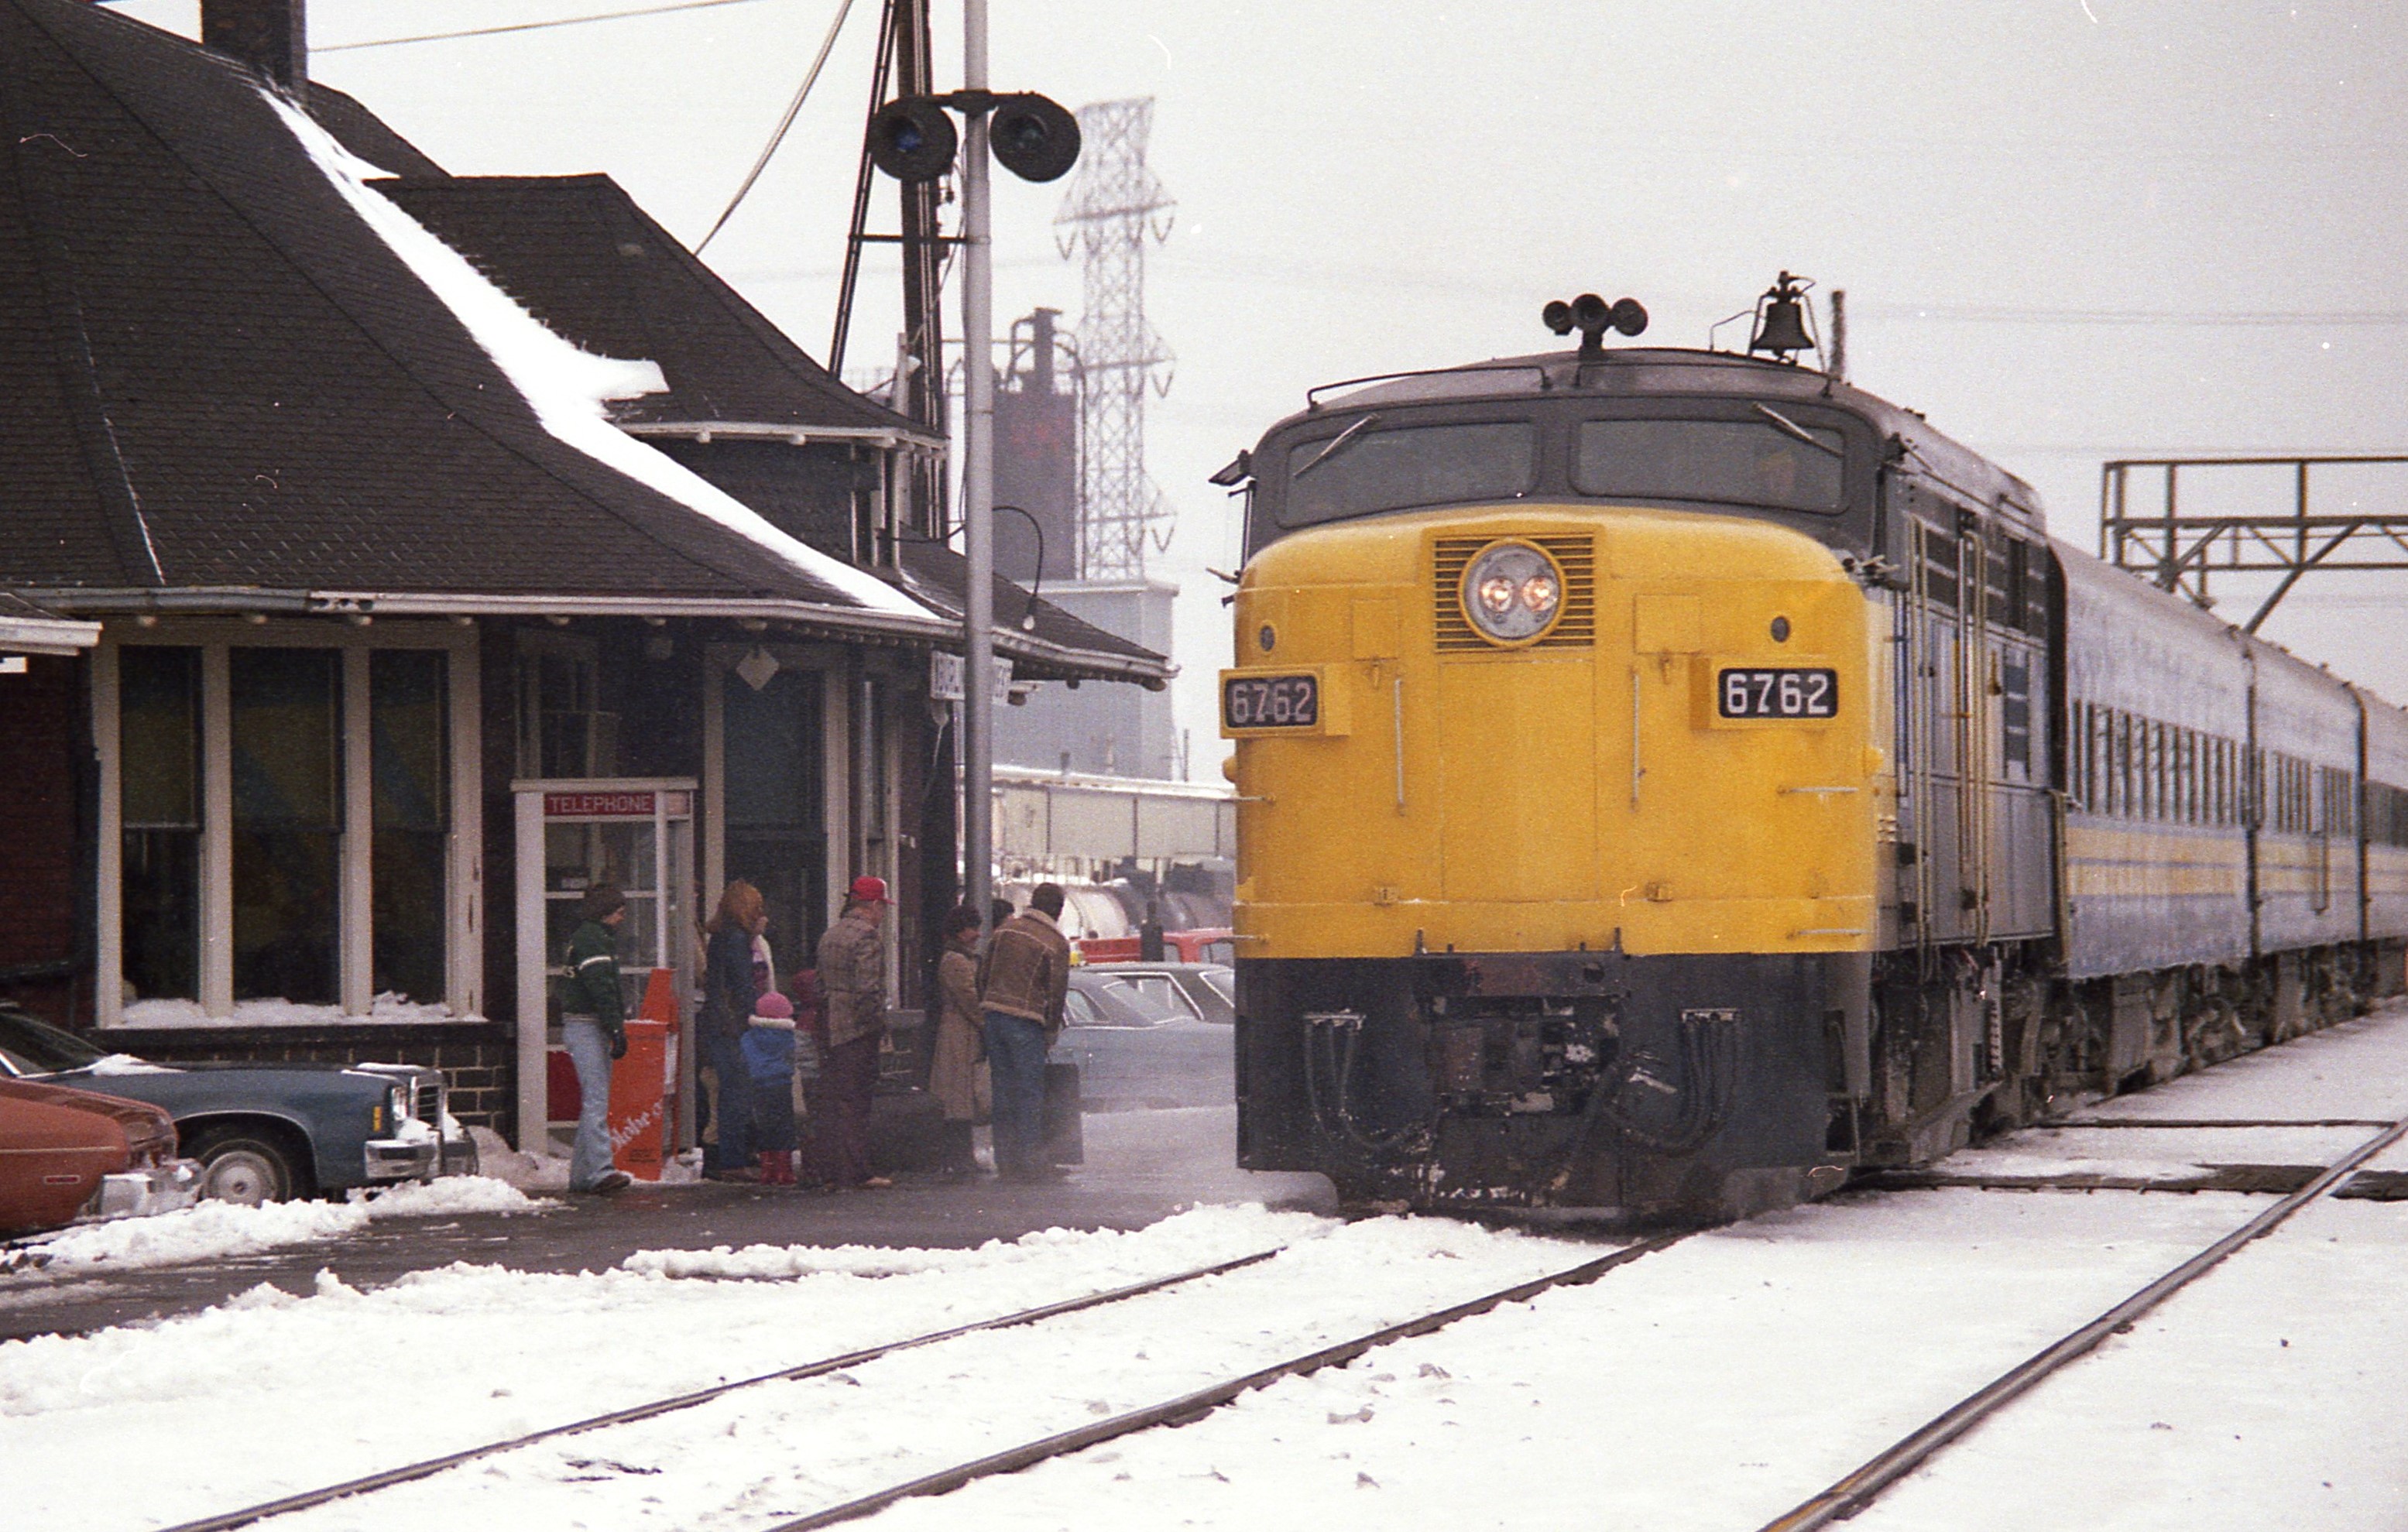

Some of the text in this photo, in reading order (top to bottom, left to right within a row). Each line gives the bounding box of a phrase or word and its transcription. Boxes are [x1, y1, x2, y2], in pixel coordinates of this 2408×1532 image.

[1233, 682, 1311, 723] 6762
[1727, 673, 1828, 714] 6762
[551, 795, 651, 812] TELEPHONE
